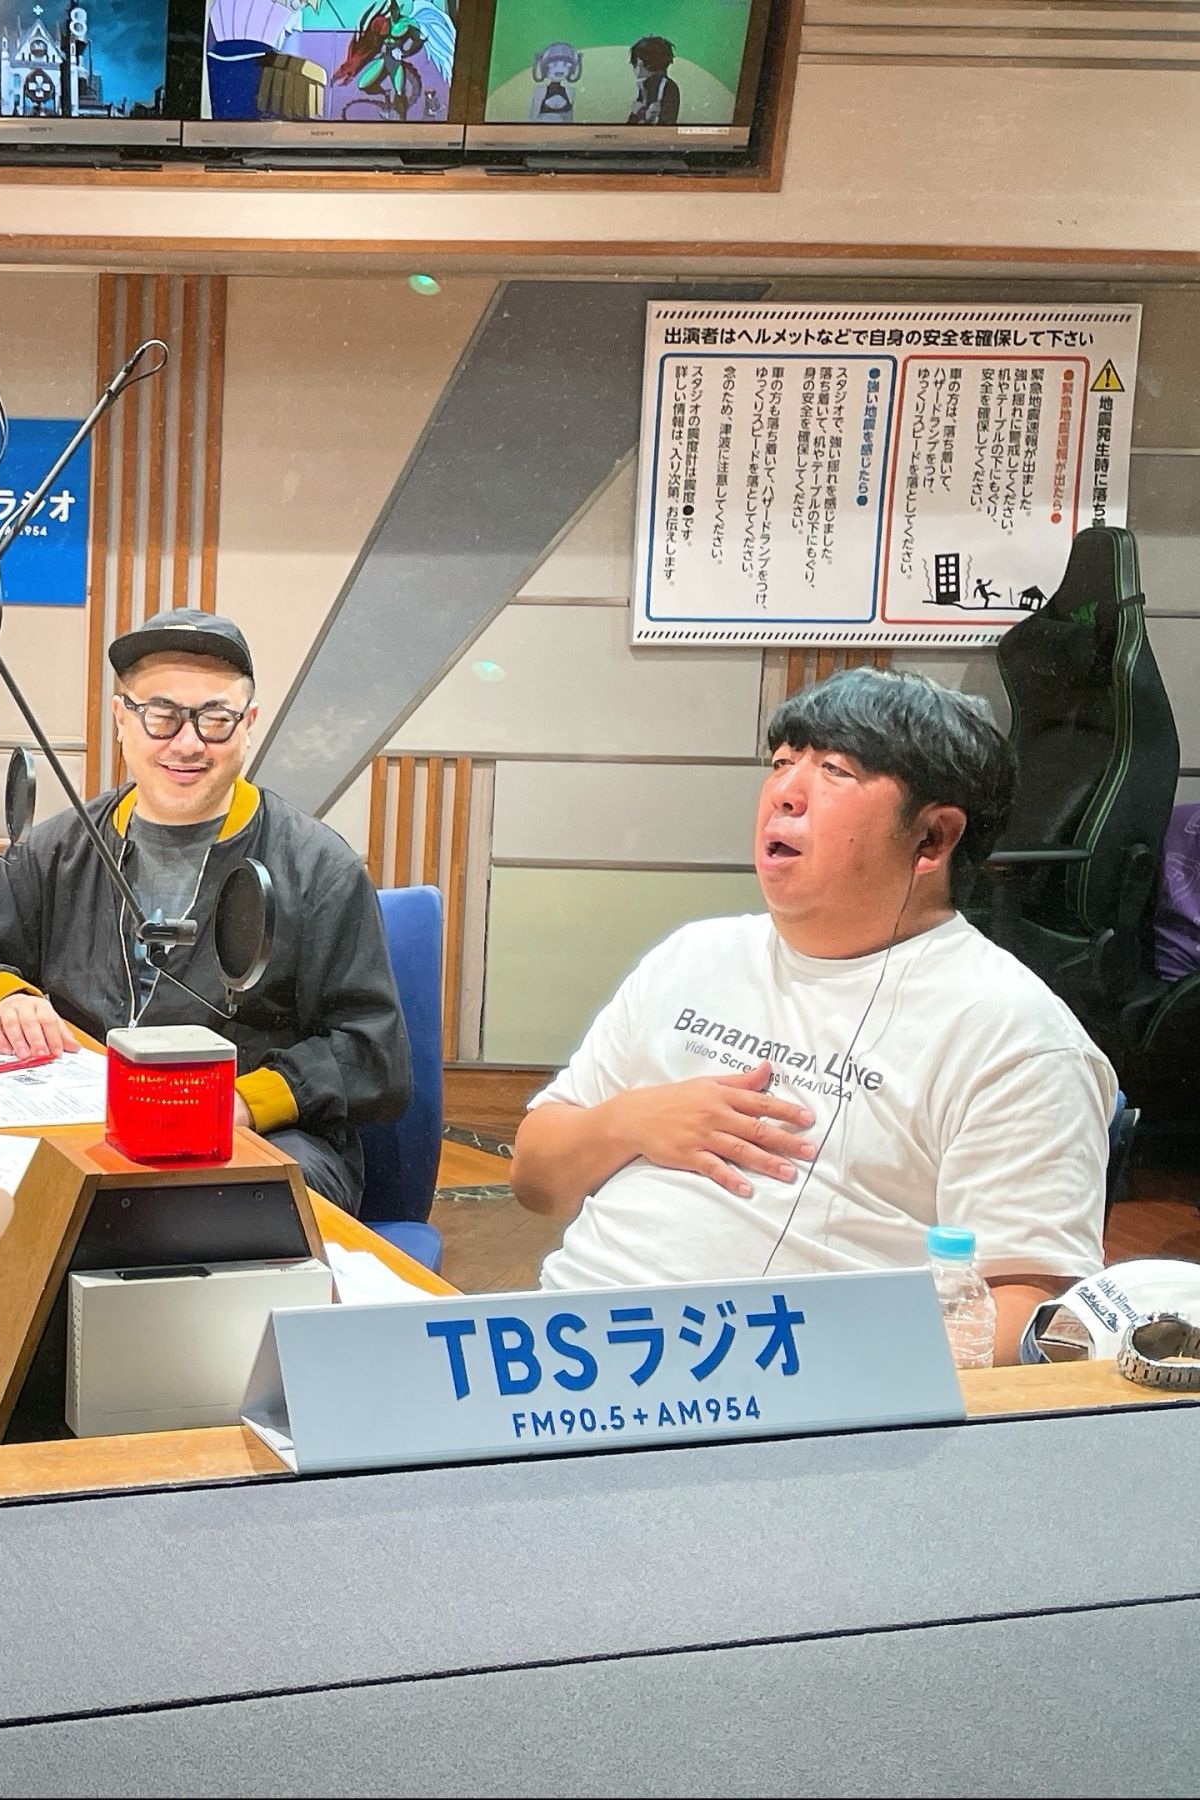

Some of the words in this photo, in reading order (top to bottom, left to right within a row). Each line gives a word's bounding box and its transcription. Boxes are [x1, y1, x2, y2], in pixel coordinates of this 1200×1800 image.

[663, 326, 1094, 348] 出演者はヘルメットなどで自身の安全を確保して下さい
[673, 1007, 817, 1075] Bananaman
[823, 1052, 884, 1092] Live
[684, 1040, 718, 1060] Video
[426, 1293, 807, 1401] TBSラジオ
[511, 1394, 762, 1438] FM90.5+AM954
